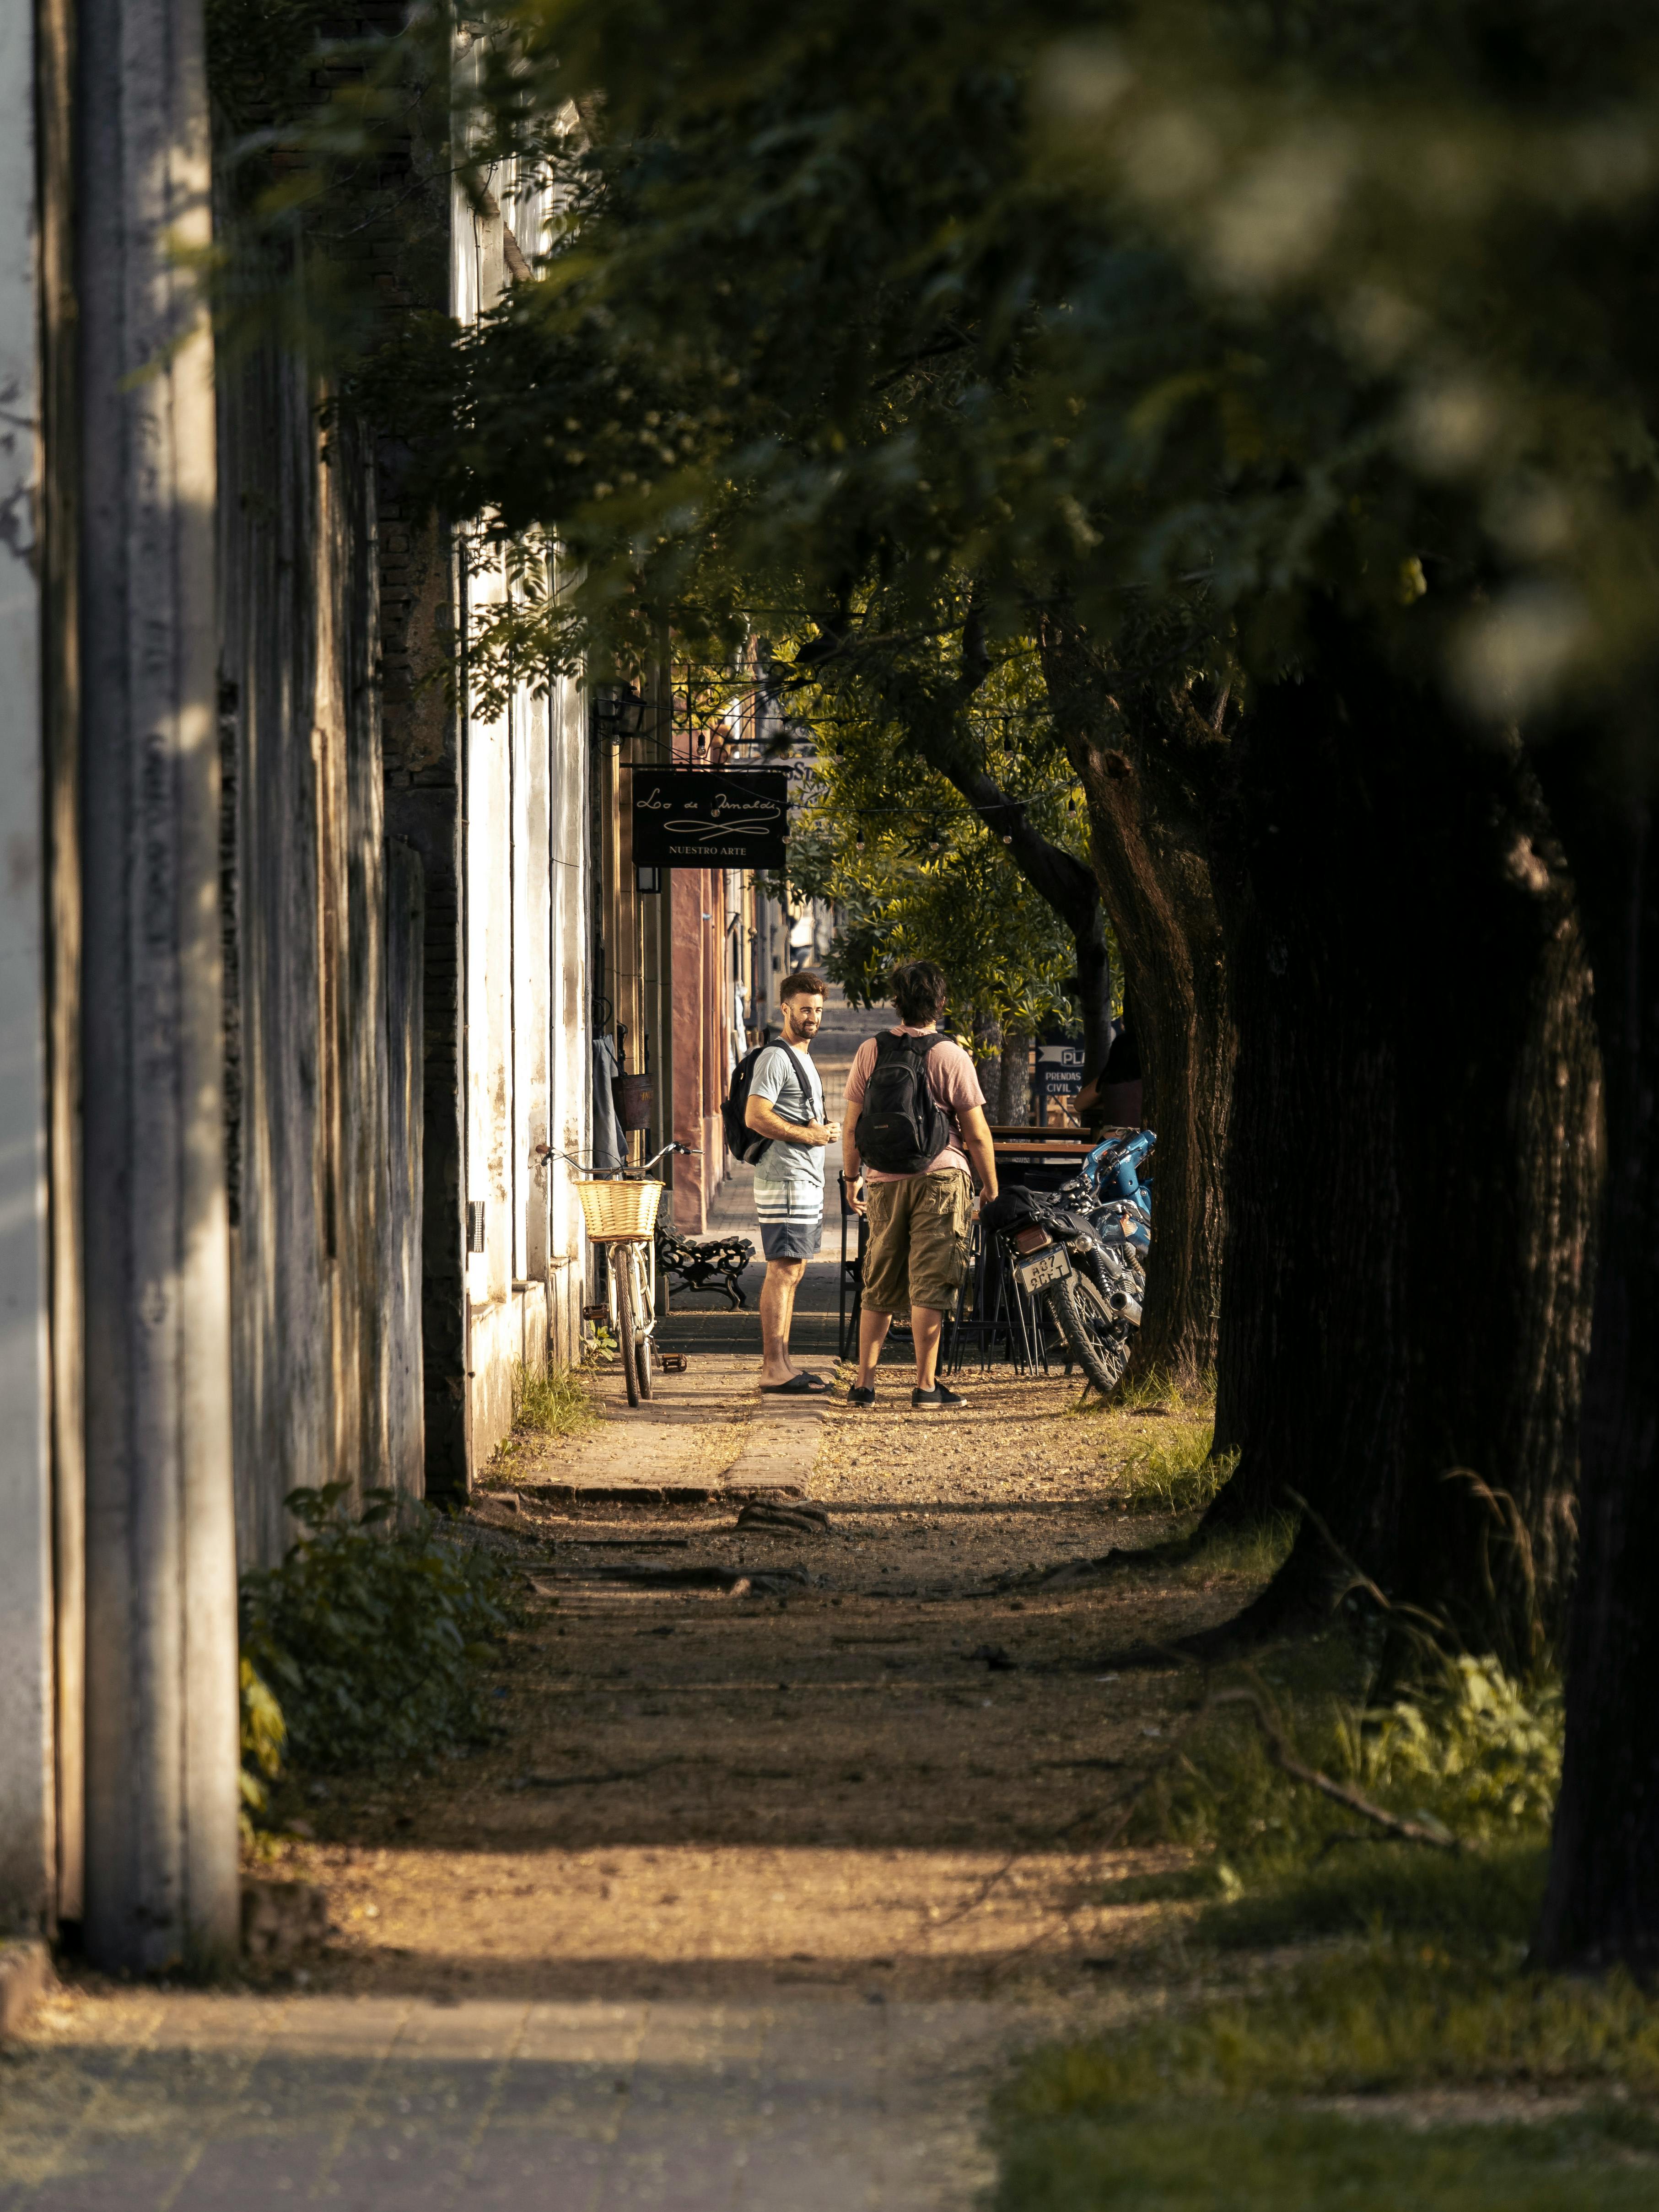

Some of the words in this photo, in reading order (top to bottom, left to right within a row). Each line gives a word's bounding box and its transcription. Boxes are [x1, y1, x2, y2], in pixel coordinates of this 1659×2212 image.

[636, 788, 672, 809] Lo
[669, 846, 718, 854] NUESTRO
[720, 847, 747, 856] ARTE
[1045, 1072, 1081, 1081] PRENDAS
[1046, 1083, 1071, 1093] CIVIL
